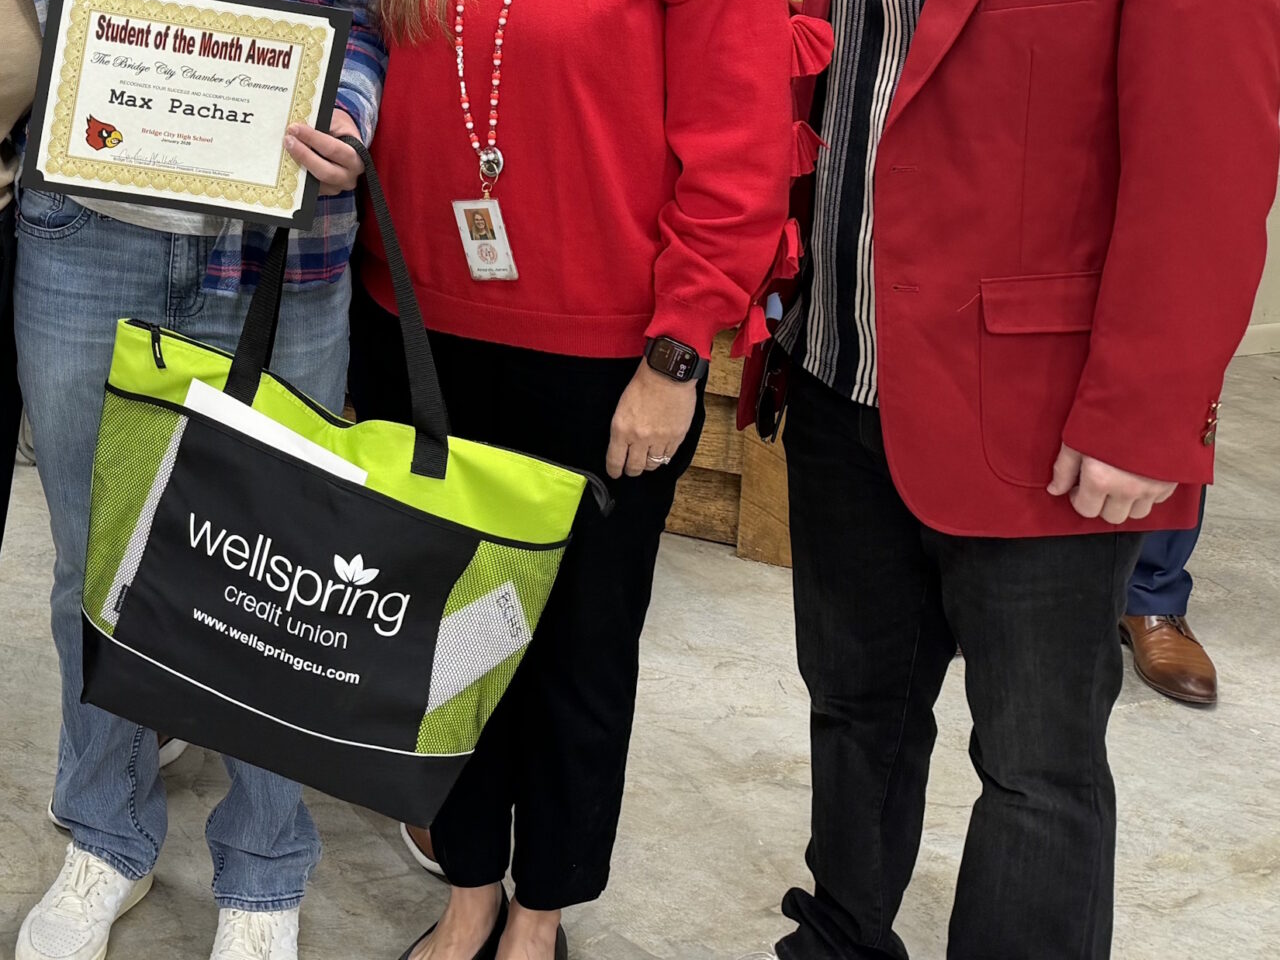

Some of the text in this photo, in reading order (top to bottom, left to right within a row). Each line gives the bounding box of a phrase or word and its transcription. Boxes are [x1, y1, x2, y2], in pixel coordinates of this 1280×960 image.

[95, 14, 294, 69] Student of the Month Award
[90, 51, 289, 93] The Bridge City Chamber of Commerce
[108, 88, 254, 124] Max Pachar
[141, 127, 213, 144] Bridge City High School
[190, 512, 411, 637] wellspring
[224, 585, 348, 650] credit union
[193, 608, 361, 685] www.wellspringcu.com
